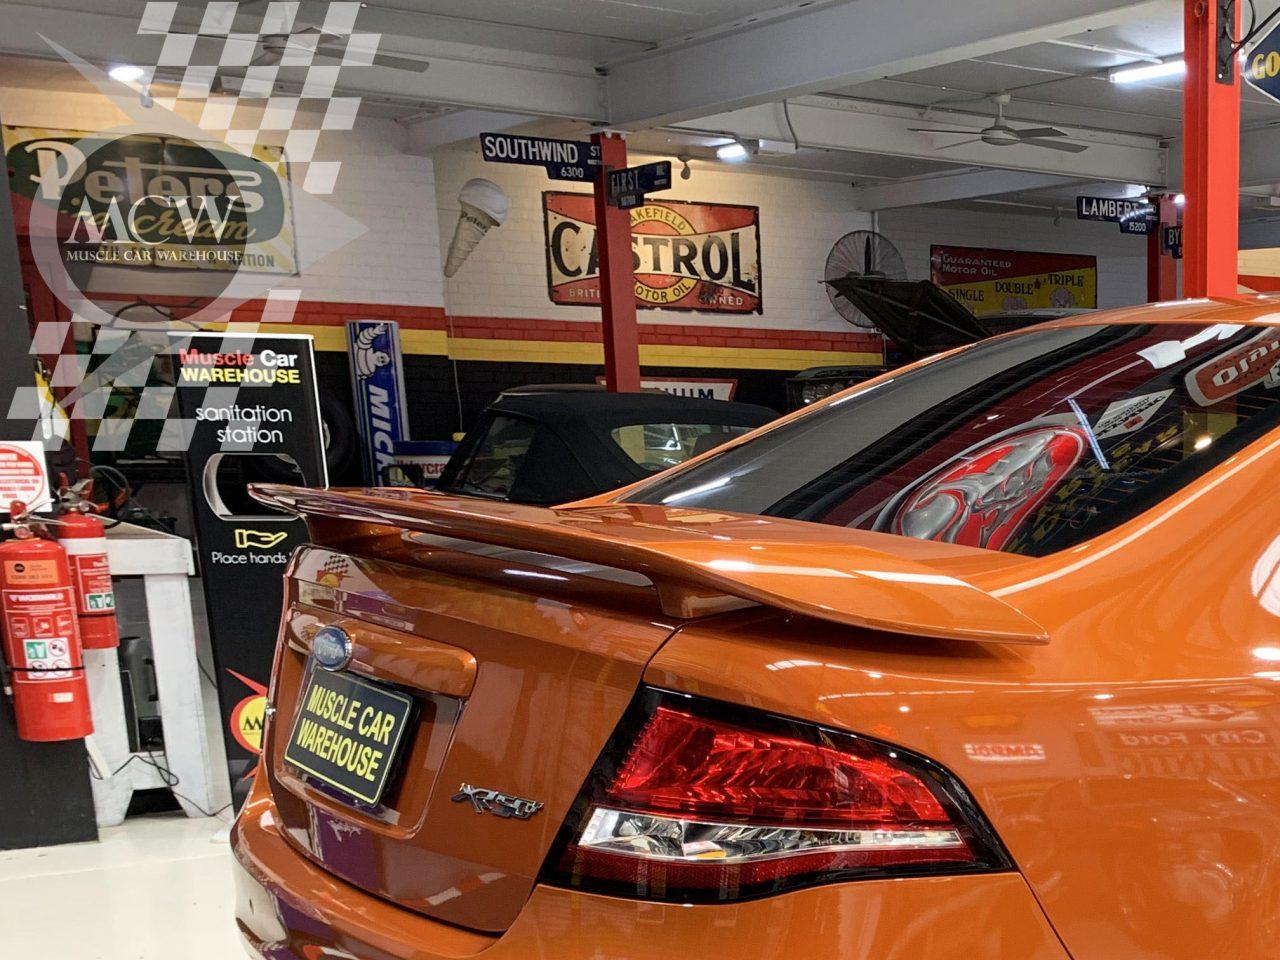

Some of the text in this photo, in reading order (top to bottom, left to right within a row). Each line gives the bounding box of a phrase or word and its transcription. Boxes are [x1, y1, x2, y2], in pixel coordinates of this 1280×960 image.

[485, 136, 579, 164] SOUTHWIND
[25, 140, 264, 213] Peters
[561, 166, 584, 178] 6300
[611, 170, 639, 196] FIRST
[1082, 198, 1141, 219] LAMBERT
[631, 208, 686, 231] AKEFIELD
[1169, 229, 1183, 245] BY
[942, 253, 1012, 268] GUARANTEED
[569, 288, 600, 299] BRITI
[635, 282, 691, 303] OTOR OIL
[179, 349, 298, 368] Muscle Car
[181, 368, 300, 384] WAREHOUSE
[196, 404, 293, 423] sanitation
[216, 426, 284, 443] station
[211, 551, 288, 564] Place hands
[306, 683, 396, 745] MUSCLE CAR
[296, 718, 384, 782] WAREHOUSE
